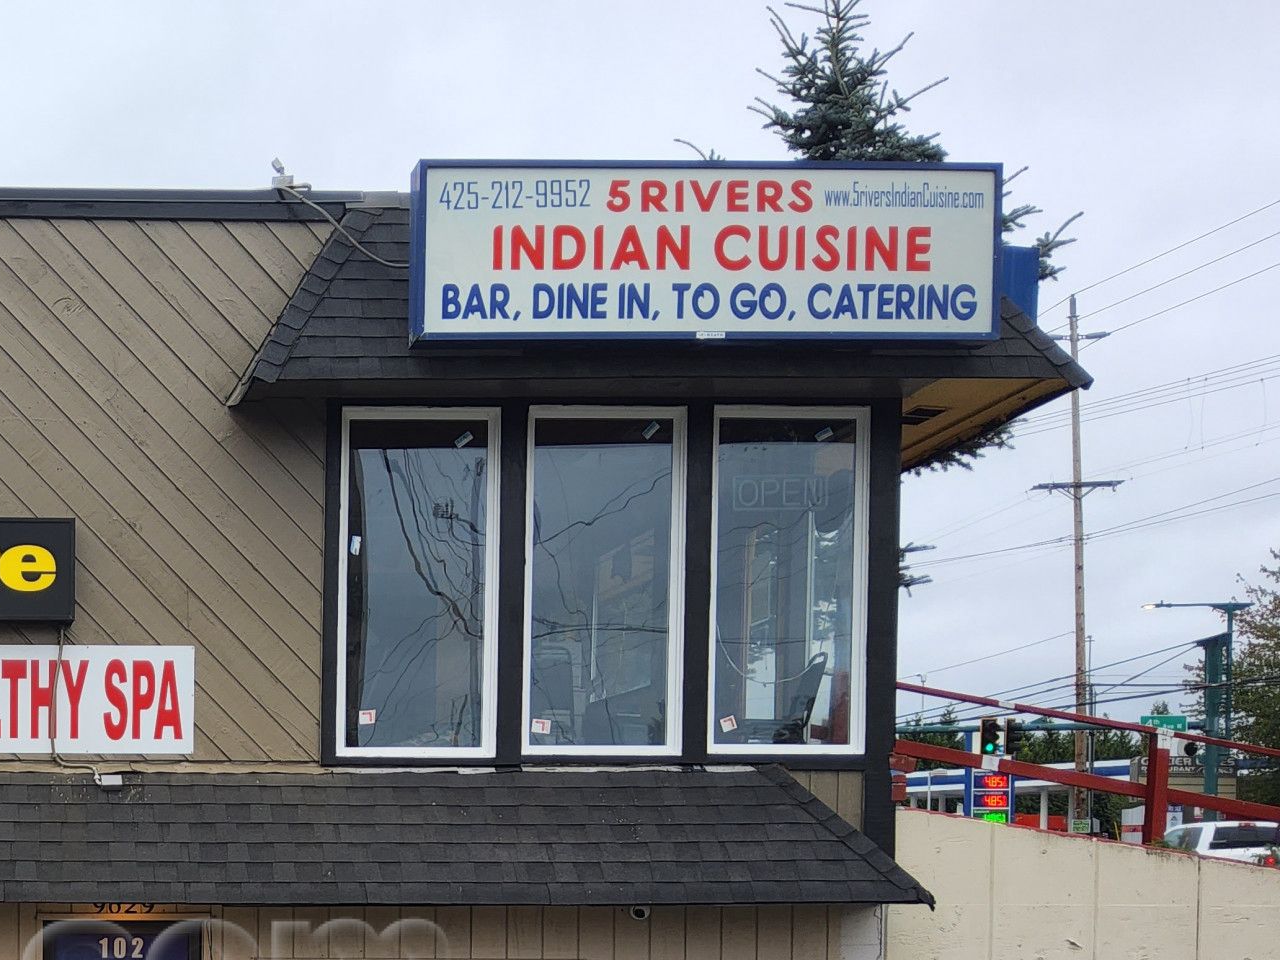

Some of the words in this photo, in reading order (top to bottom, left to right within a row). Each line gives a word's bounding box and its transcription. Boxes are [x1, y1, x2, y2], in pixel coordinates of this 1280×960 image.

[439, 179, 591, 210] 425-212-9952
[640, 179, 814, 213] RIVERS
[824, 181, 985, 209] www.5riversIndianCuisine.com
[492, 224, 691, 270] INDIAN
[714, 224, 932, 271] CUISINE
[441, 283, 521, 321] BAR,
[532, 282, 608, 319] DINE
[618, 282, 660, 321] IN,
[672, 282, 720, 320] TO
[729, 282, 796, 322] GO,
[807, 283, 978, 321] CATERING
[739, 479, 824, 506] OPEN
[103, 658, 183, 741] SPA
[99, 937, 144, 959] 102
